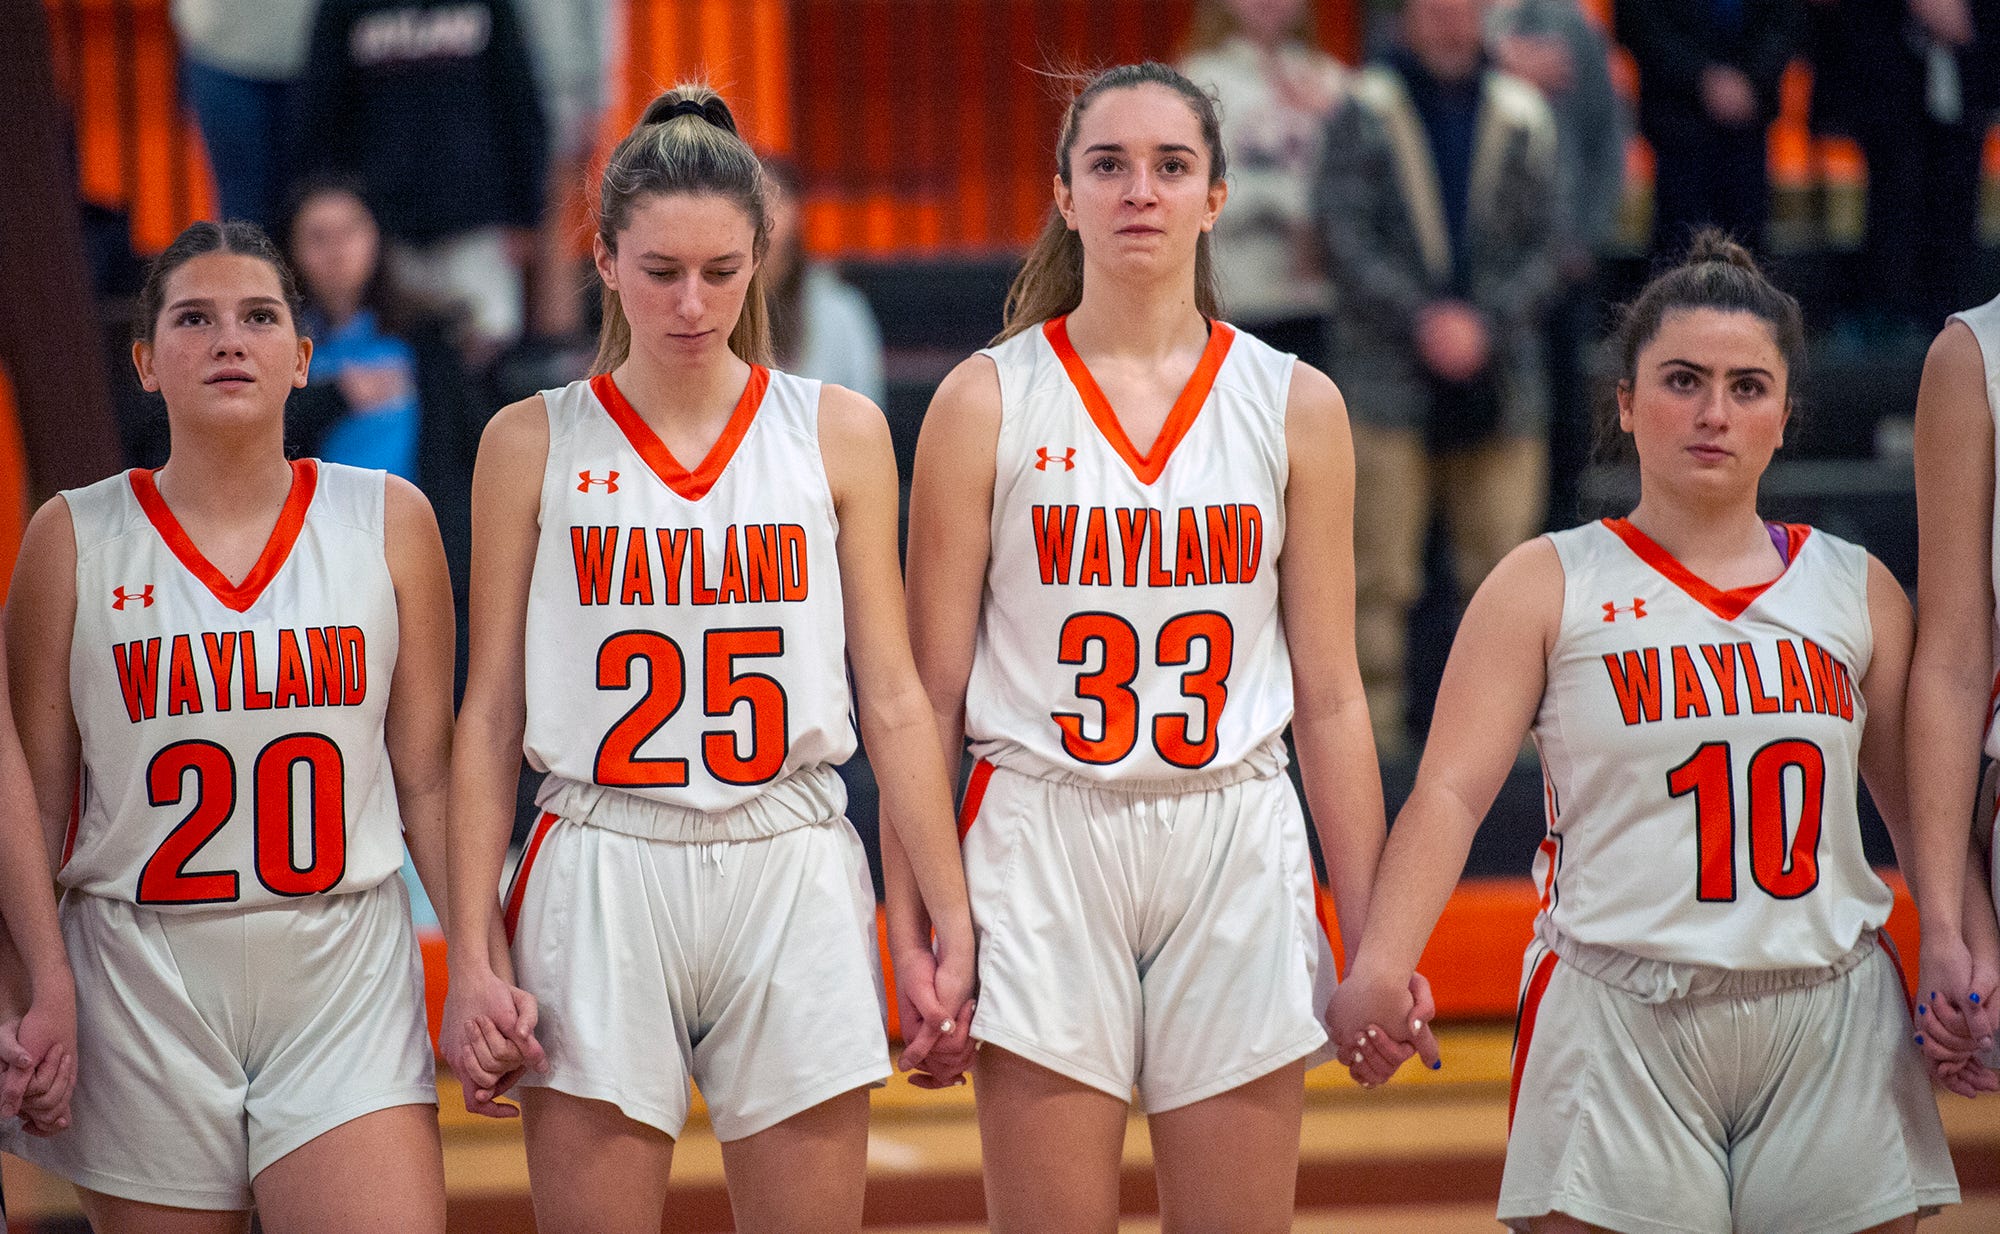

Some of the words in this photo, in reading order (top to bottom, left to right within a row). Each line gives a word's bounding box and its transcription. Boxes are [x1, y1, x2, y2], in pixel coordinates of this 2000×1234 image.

[570, 523, 809, 606] WAYLAND
[1032, 503, 1263, 587] WAYLAND
[112, 624, 367, 724] WAYLAND
[593, 626, 789, 788] 25
[1051, 609, 1235, 770] 33
[1602, 638, 1855, 726] WAYLAND
[136, 732, 347, 906] 20
[1666, 737, 1826, 902] 10
